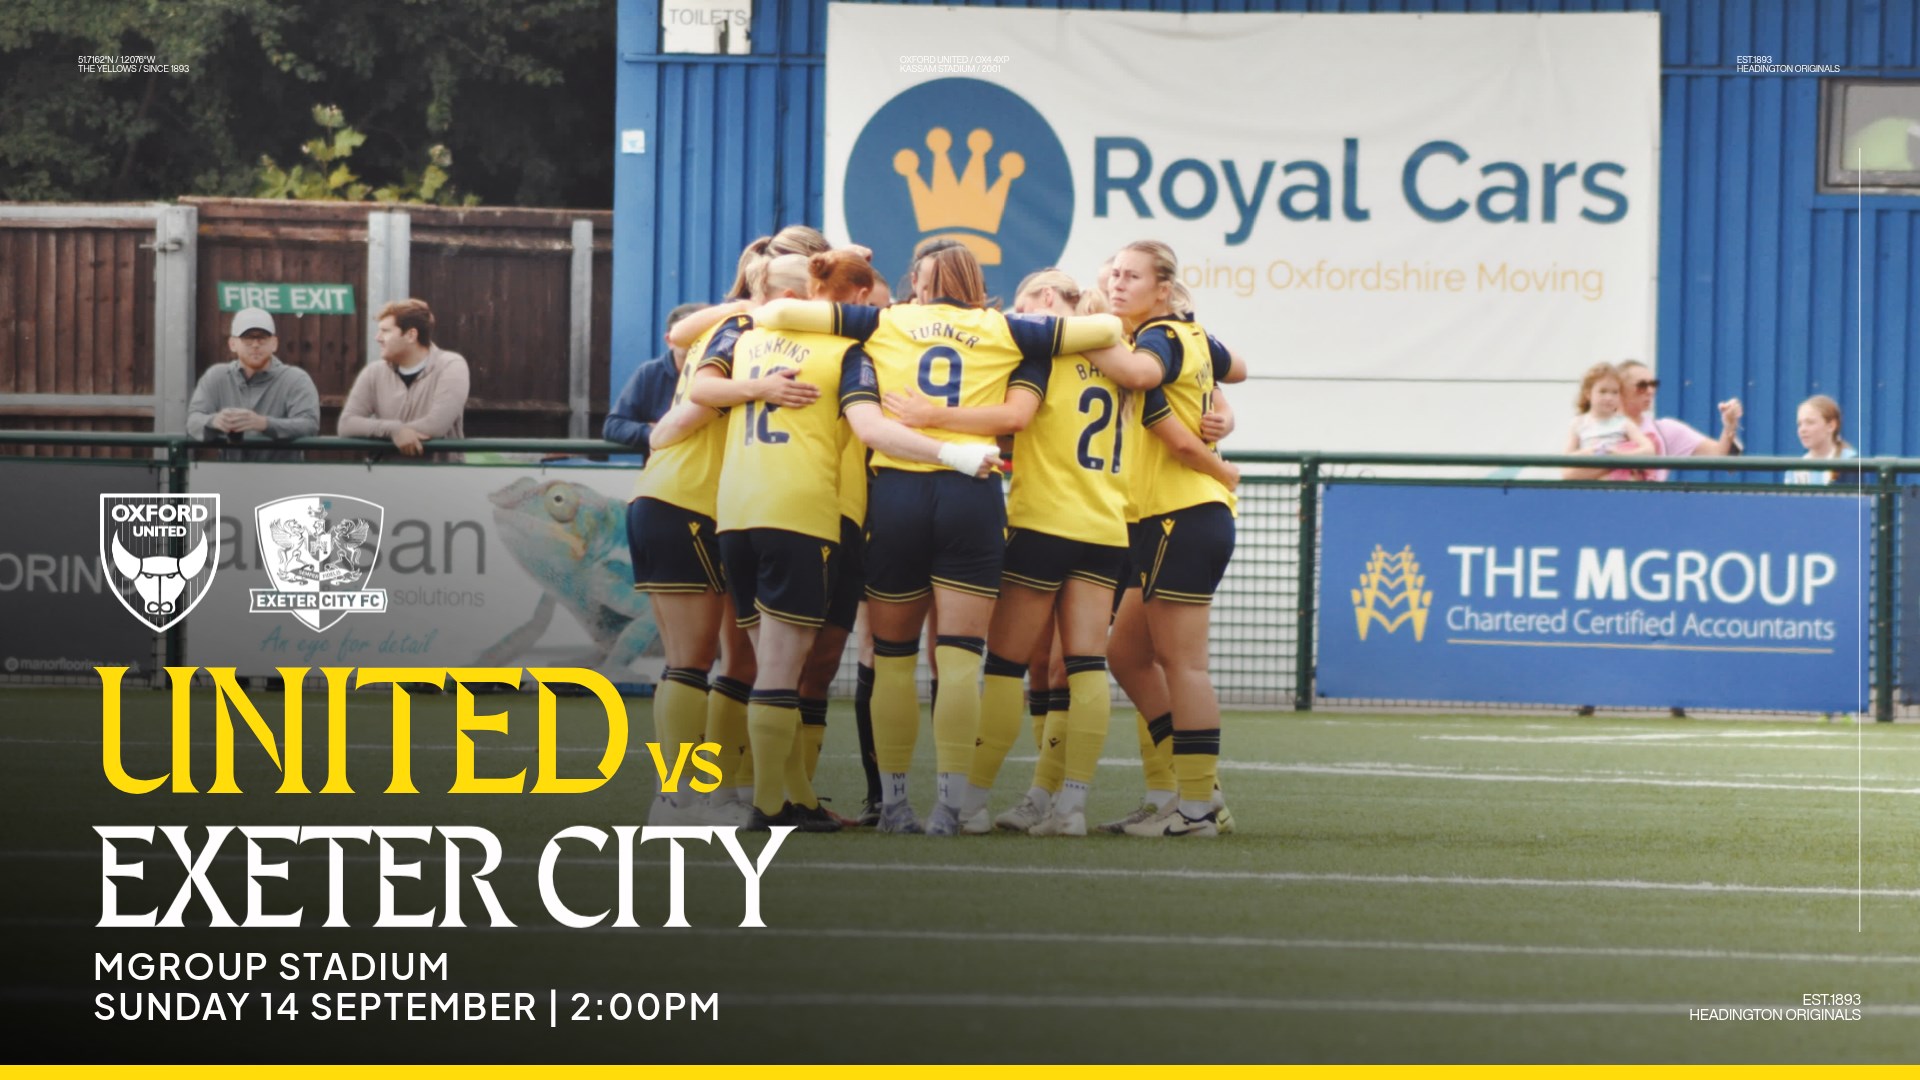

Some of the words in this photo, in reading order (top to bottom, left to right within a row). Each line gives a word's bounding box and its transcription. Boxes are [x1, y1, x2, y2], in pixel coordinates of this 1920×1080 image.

[668, 8, 748, 26] TOILETS
[1092, 136, 1371, 246] Royal
[1401, 139, 1630, 225] Cars
[1182, 256, 1256, 299] ping
[1267, 258, 1466, 294] Oxfordshire
[1476, 262, 1604, 302] Moving
[223, 286, 282, 309] FIRE
[289, 287, 349, 310] EXIT
[748, 337, 810, 364] JENKINS
[916, 345, 963, 407] 9
[1077, 385, 1123, 474] 21
[1447, 545, 1560, 599] THE
[1574, 547, 1837, 606] MGROUP
[393, 586, 485, 608] solutions
[1447, 605, 1567, 635] Chartered
[1573, 608, 1676, 637] Certified
[1682, 613, 1835, 641] Accountants
[336, 629, 371, 663] for
